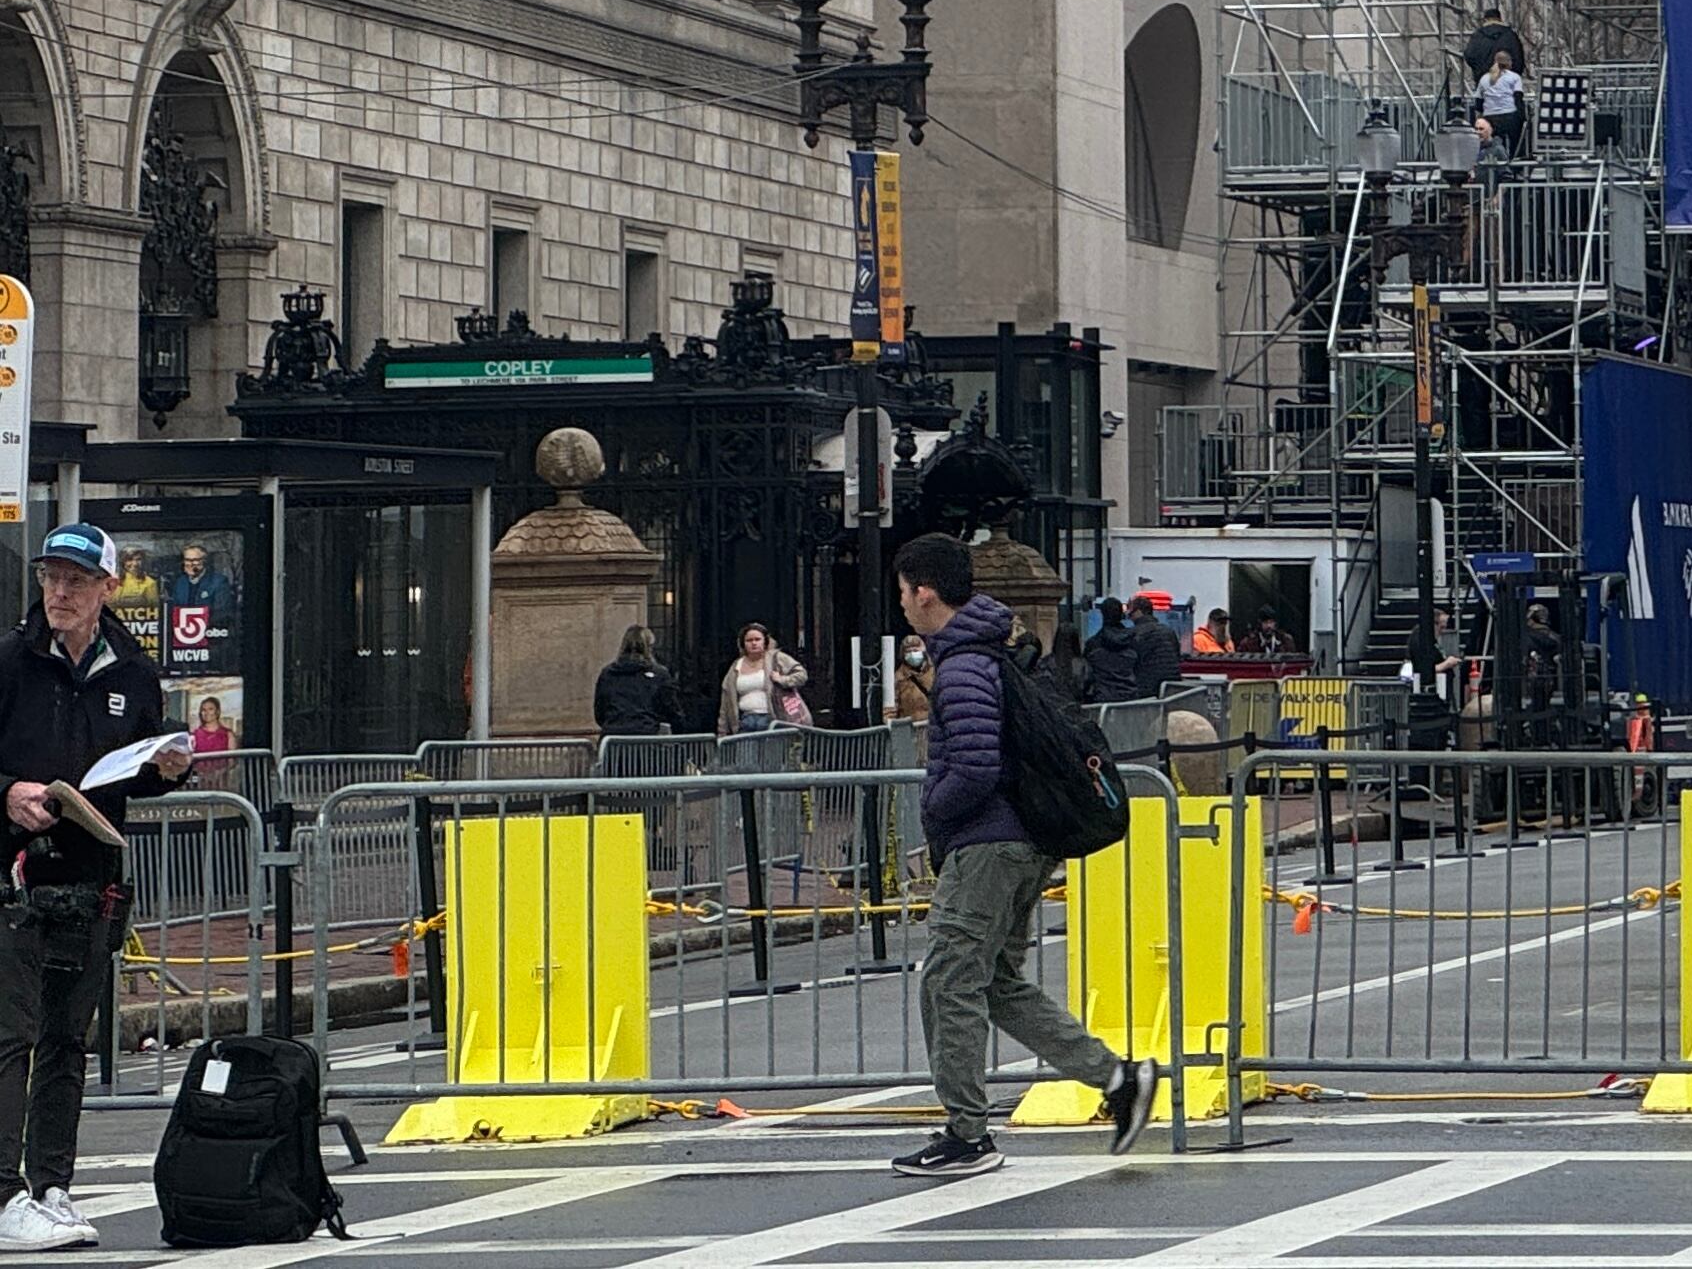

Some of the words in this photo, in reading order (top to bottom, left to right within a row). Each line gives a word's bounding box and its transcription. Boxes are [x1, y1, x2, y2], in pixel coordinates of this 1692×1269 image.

[485, 360, 554, 376] COPLEY
[113, 607, 159, 620] ATCH
[123, 621, 159, 635] IVE
[174, 607, 207, 644] 5
[172, 649, 209, 662] WCVB
